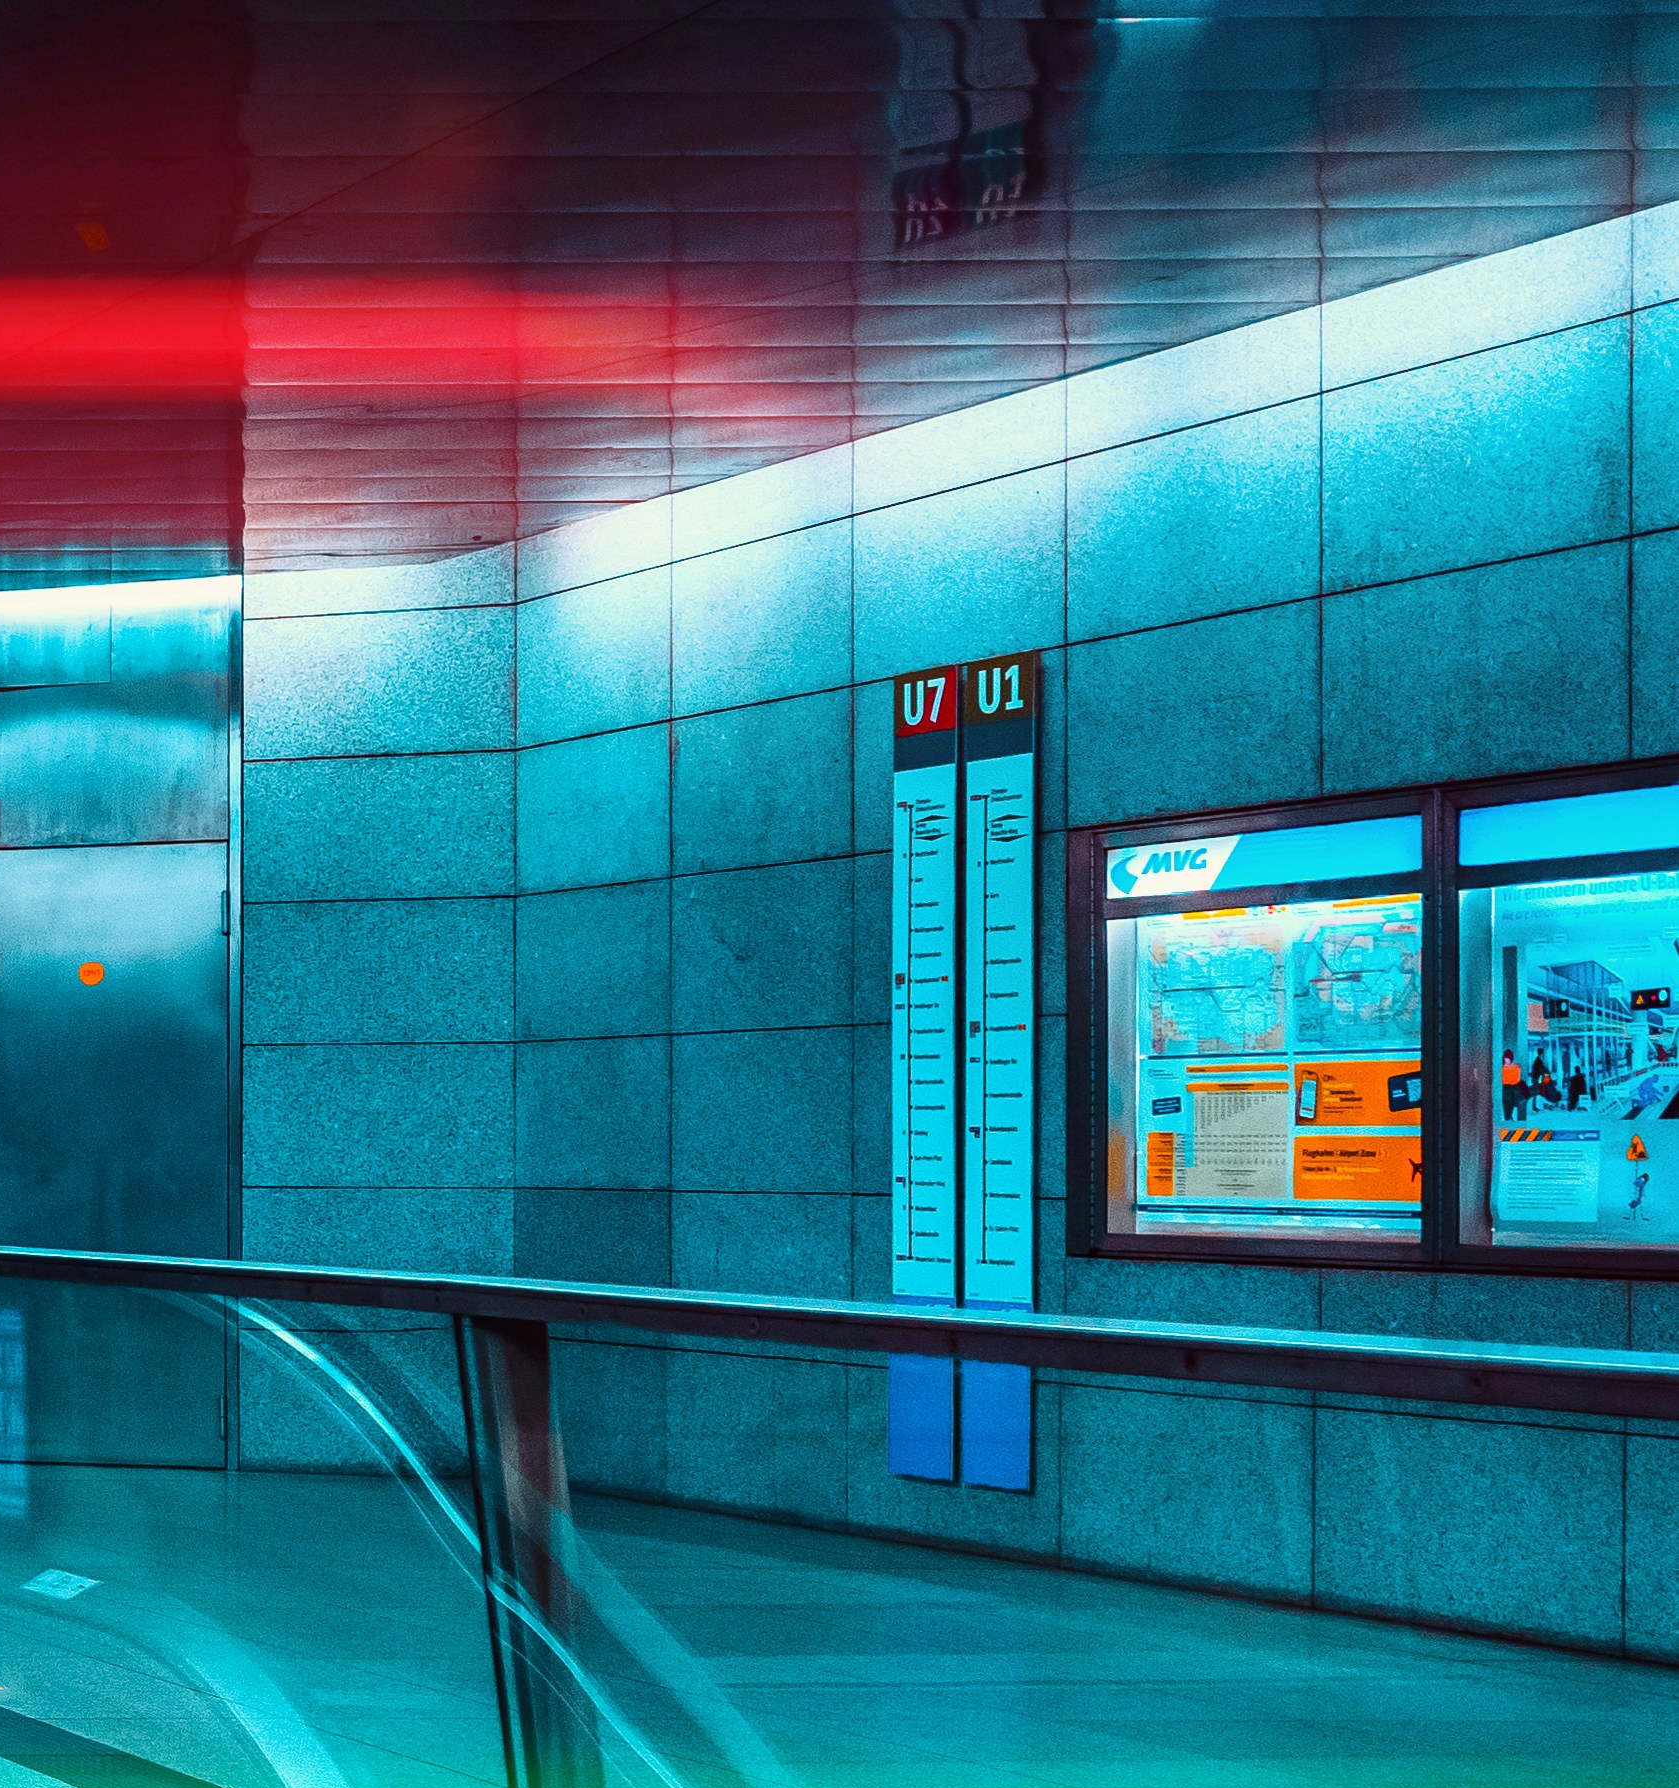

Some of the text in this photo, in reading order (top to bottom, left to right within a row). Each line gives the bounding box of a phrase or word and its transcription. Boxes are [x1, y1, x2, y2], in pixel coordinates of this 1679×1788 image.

[903, 677, 946, 726] U7
[978, 664, 1024, 714] U1
[1142, 848, 1207, 874] MVG
[1524, 883, 1587, 900] erneuern
[1588, 877, 1637, 896] unsere
